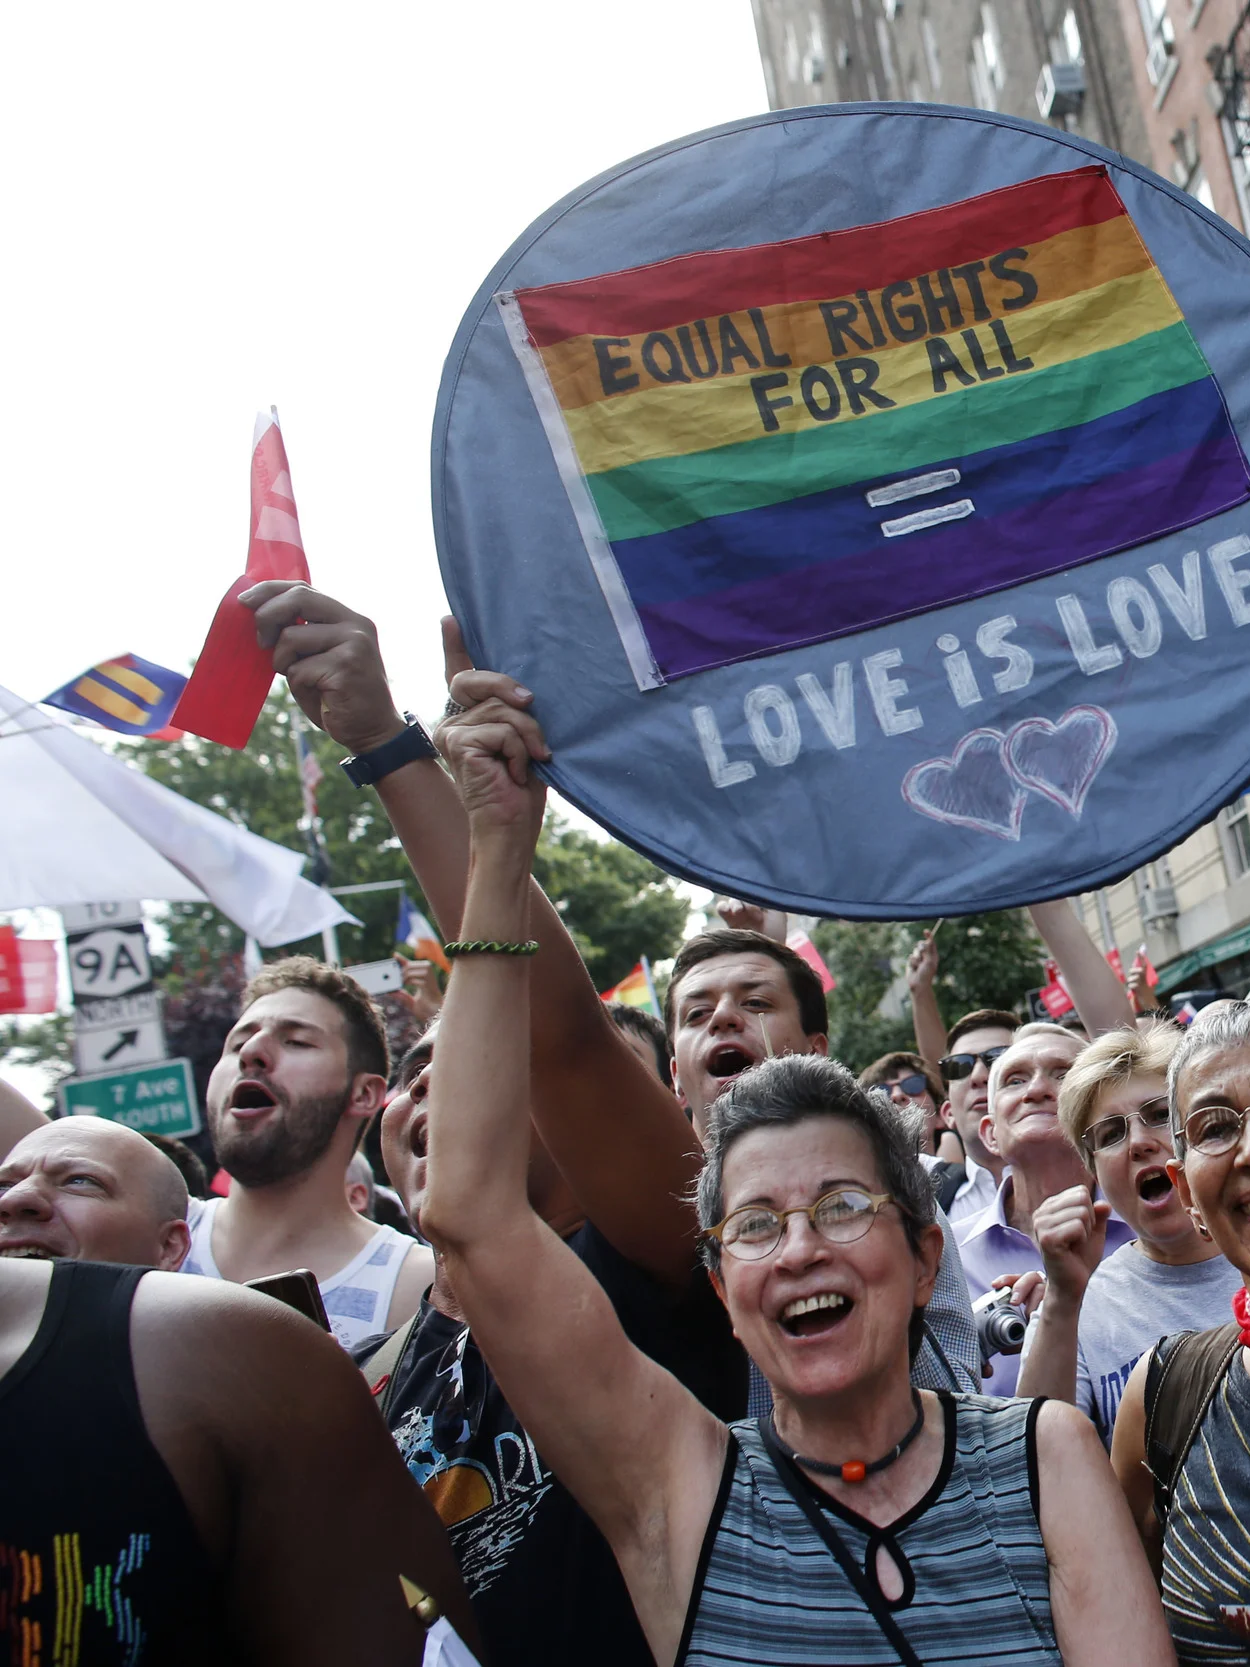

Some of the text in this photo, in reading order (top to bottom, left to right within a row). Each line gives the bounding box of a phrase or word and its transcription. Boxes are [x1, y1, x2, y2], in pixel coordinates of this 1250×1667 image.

[593, 247, 1038, 396] EQUAL RIGHTS
[750, 320, 1034, 431] FOR ALL
[692, 647, 924, 788] LOVE
[75, 942, 141, 984] 9A
[136, 1077, 180, 1100] Ave
